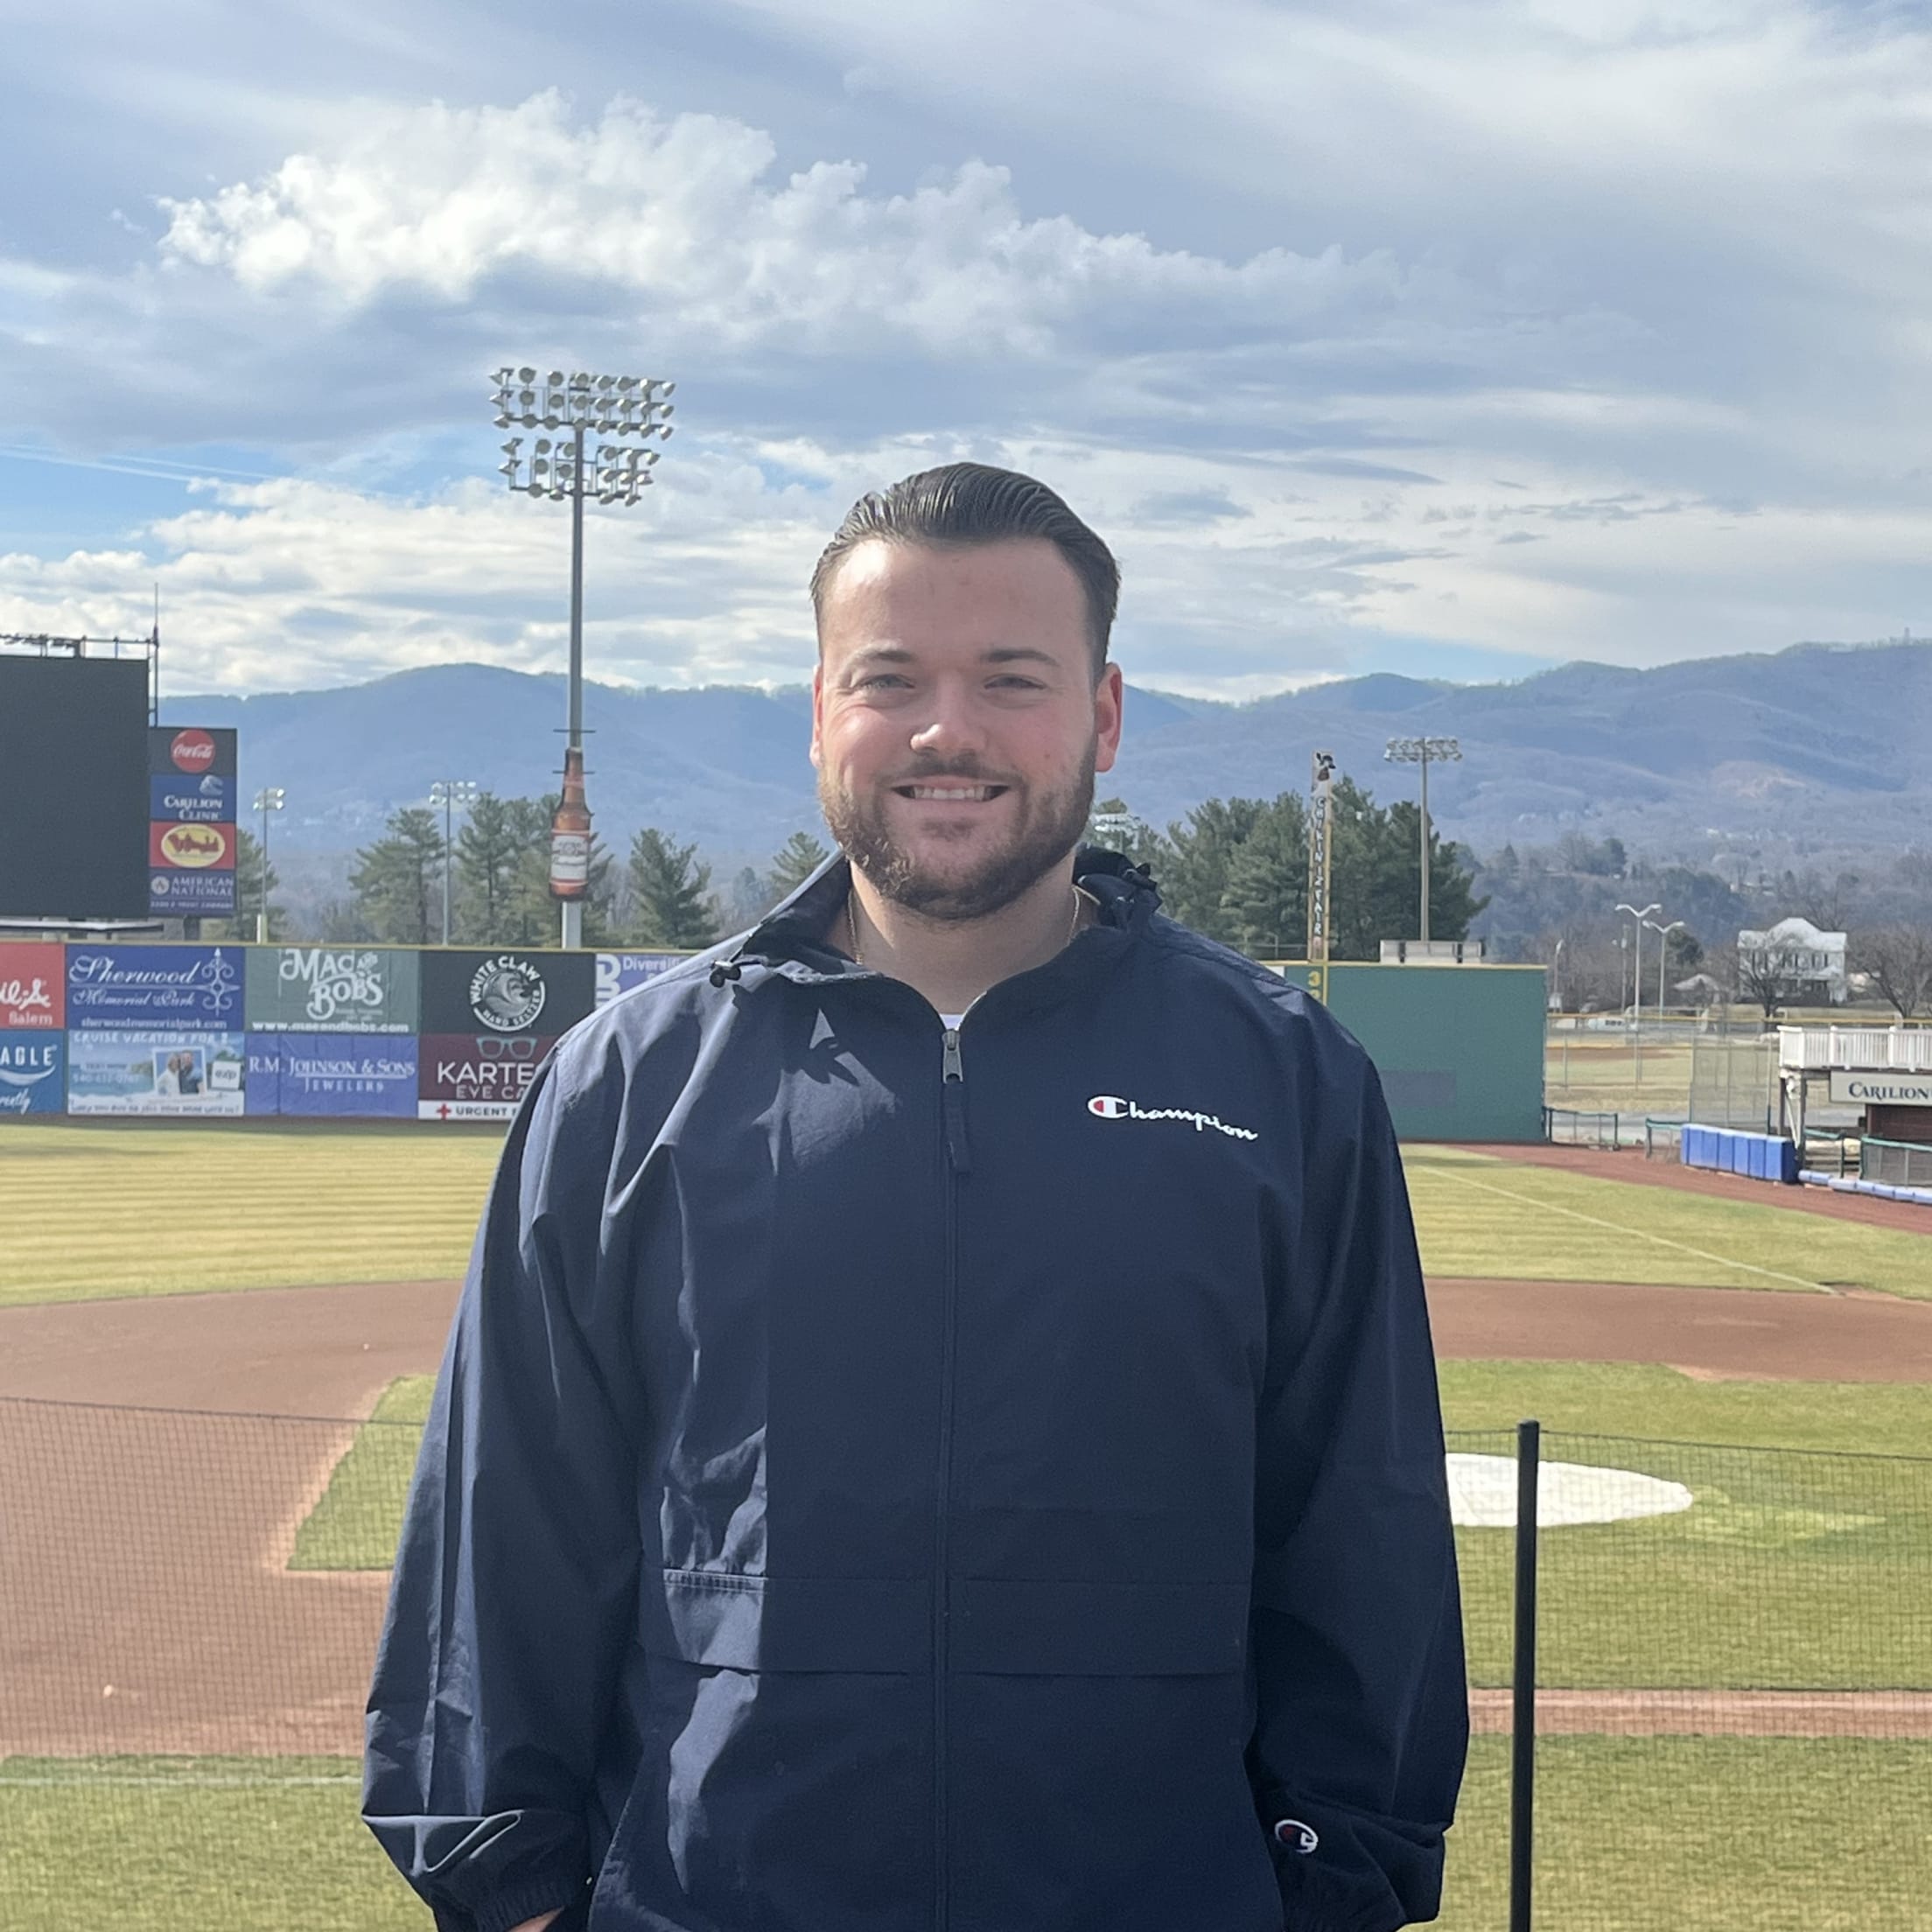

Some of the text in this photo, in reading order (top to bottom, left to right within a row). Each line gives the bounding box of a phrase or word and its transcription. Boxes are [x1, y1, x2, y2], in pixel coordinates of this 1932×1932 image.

[68, 955, 201, 984] Sherwood
[469, 956, 541, 1005] WHITE CLAW
[74, 1032, 119, 1044] CRUISE
[123, 1032, 186, 1045] VACATION
[288, 1057, 357, 1077] JOHNSON
[361, 1059, 374, 1074] &
[377, 1058, 416, 1076] SONS
[305, 1078, 385, 1093] JEWELERS
[456, 1085, 493, 1099] EYE
[1848, 1082, 1929, 1101] CARILION
[456, 1105, 508, 1116] URGENT
[1088, 1096, 1258, 1140] Champion
